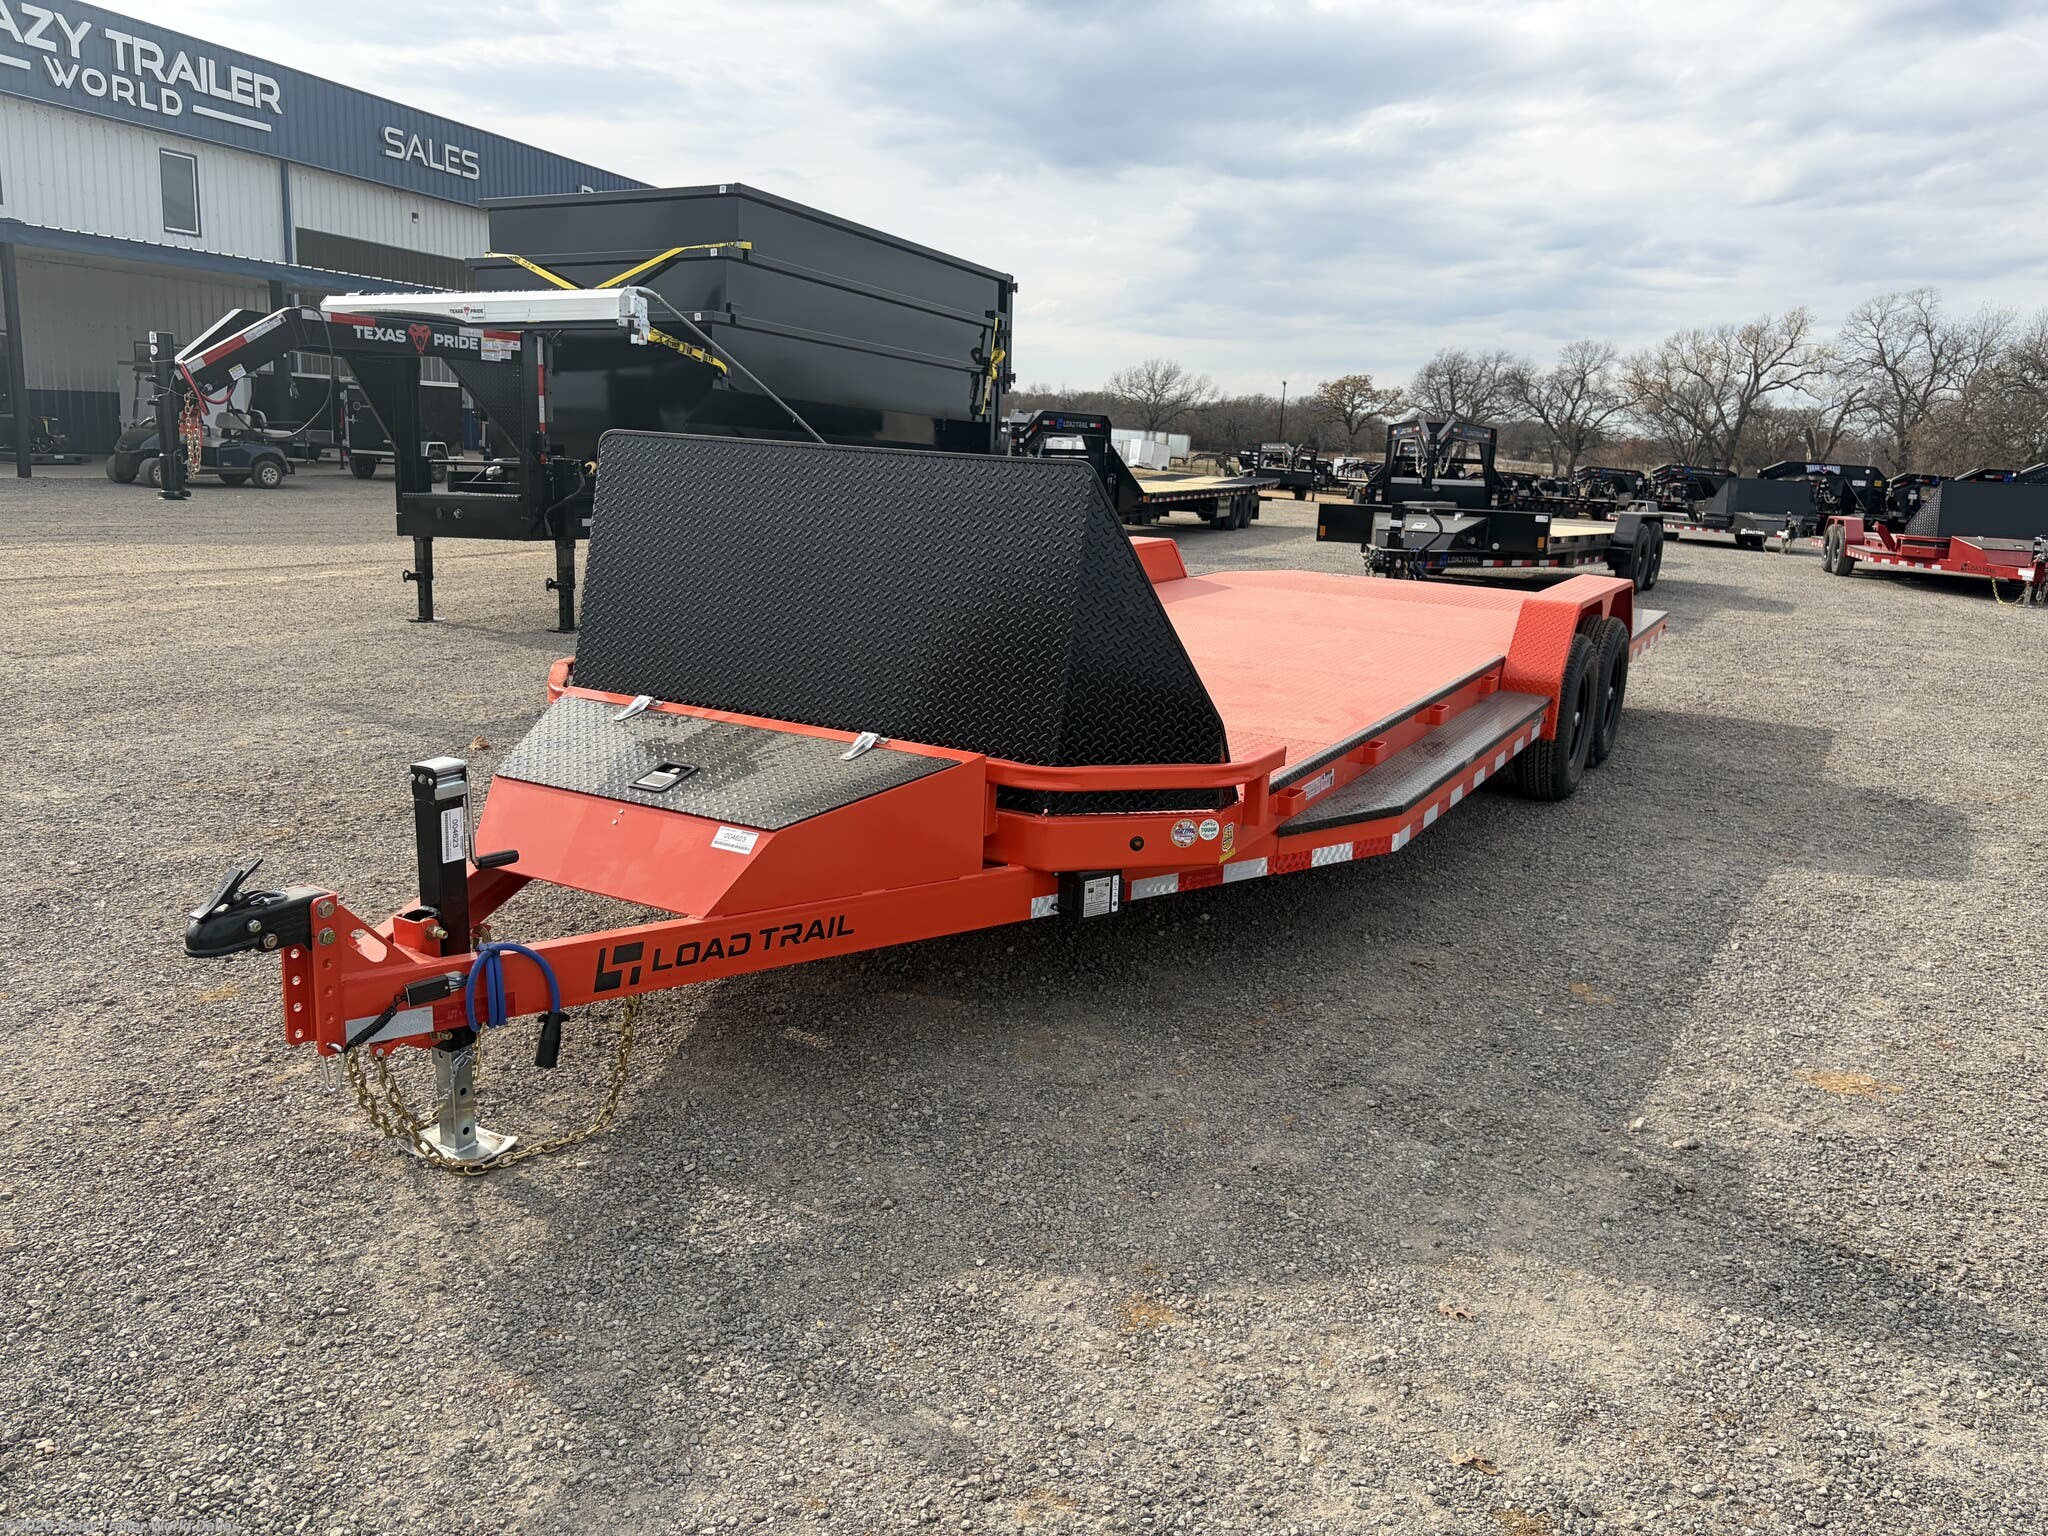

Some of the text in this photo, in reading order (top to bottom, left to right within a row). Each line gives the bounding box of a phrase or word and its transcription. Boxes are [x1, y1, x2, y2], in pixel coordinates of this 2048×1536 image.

[42, 55, 183, 116] WORLD
[104, 27, 283, 115] TRAILER
[384, 126, 480, 180] SALES
[352, 324, 407, 343] TEXAS
[433, 333, 479, 350] PRIDE
[652, 932, 752, 971] LOAD
[760, 915, 855, 951] TRAIL
